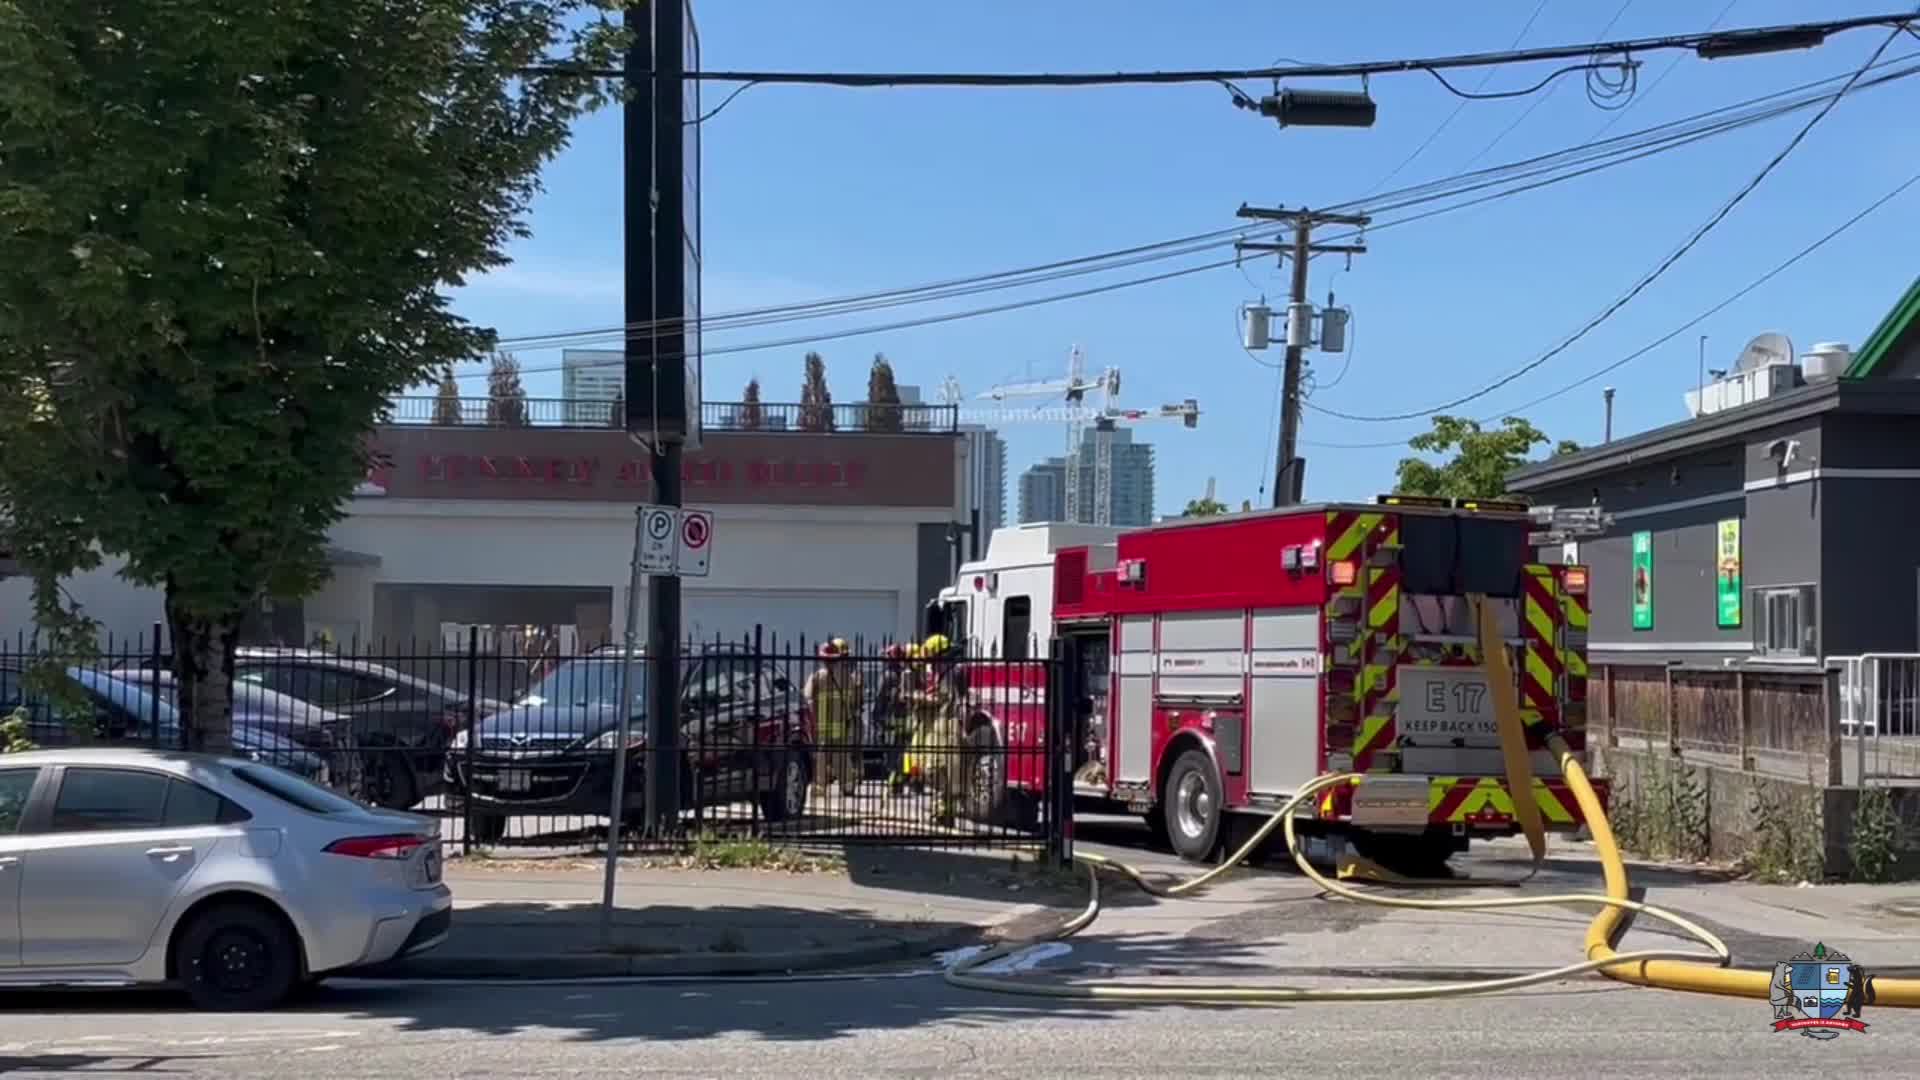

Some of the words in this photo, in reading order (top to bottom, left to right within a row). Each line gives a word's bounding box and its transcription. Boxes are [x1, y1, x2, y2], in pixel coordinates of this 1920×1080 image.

[1425, 681, 1446, 713] E
[1452, 682, 1487, 714] 17
[1406, 720, 1438, 732] KEEP
[1441, 720, 1474, 733] BACK
